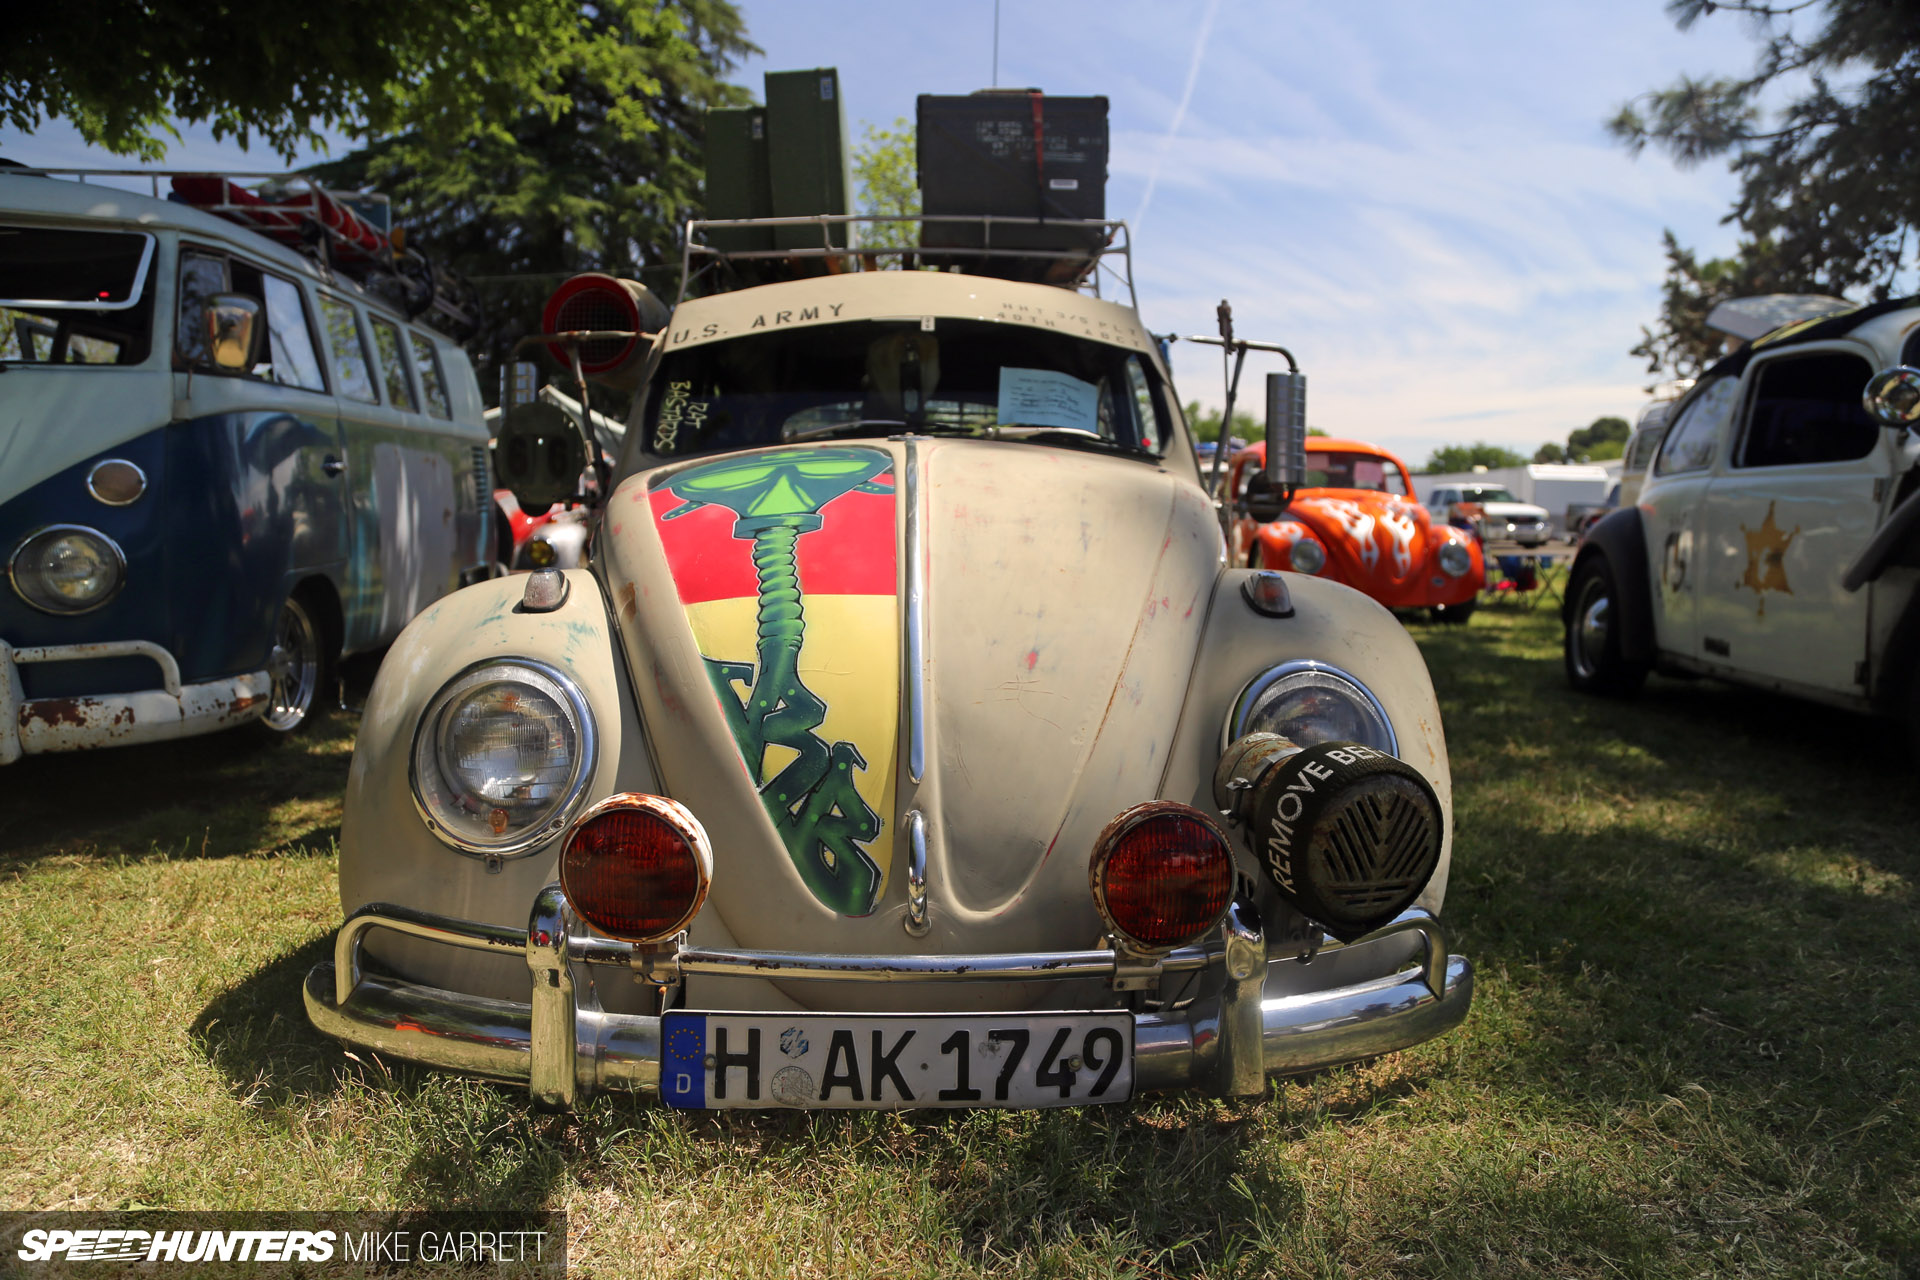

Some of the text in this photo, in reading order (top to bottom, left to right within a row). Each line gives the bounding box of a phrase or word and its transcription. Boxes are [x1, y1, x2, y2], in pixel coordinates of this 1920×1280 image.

[672, 302, 844, 344] U.S. ARMY
[653, 380, 692, 450] BASTARDS
[684, 402, 710, 429] RAT
[1267, 760, 1335, 895] REMOVE
[675, 1073, 692, 1094] D
[714, 1027, 761, 1100] H
[818, 1029, 918, 1101] AK
[937, 1027, 1125, 1101] 1749
